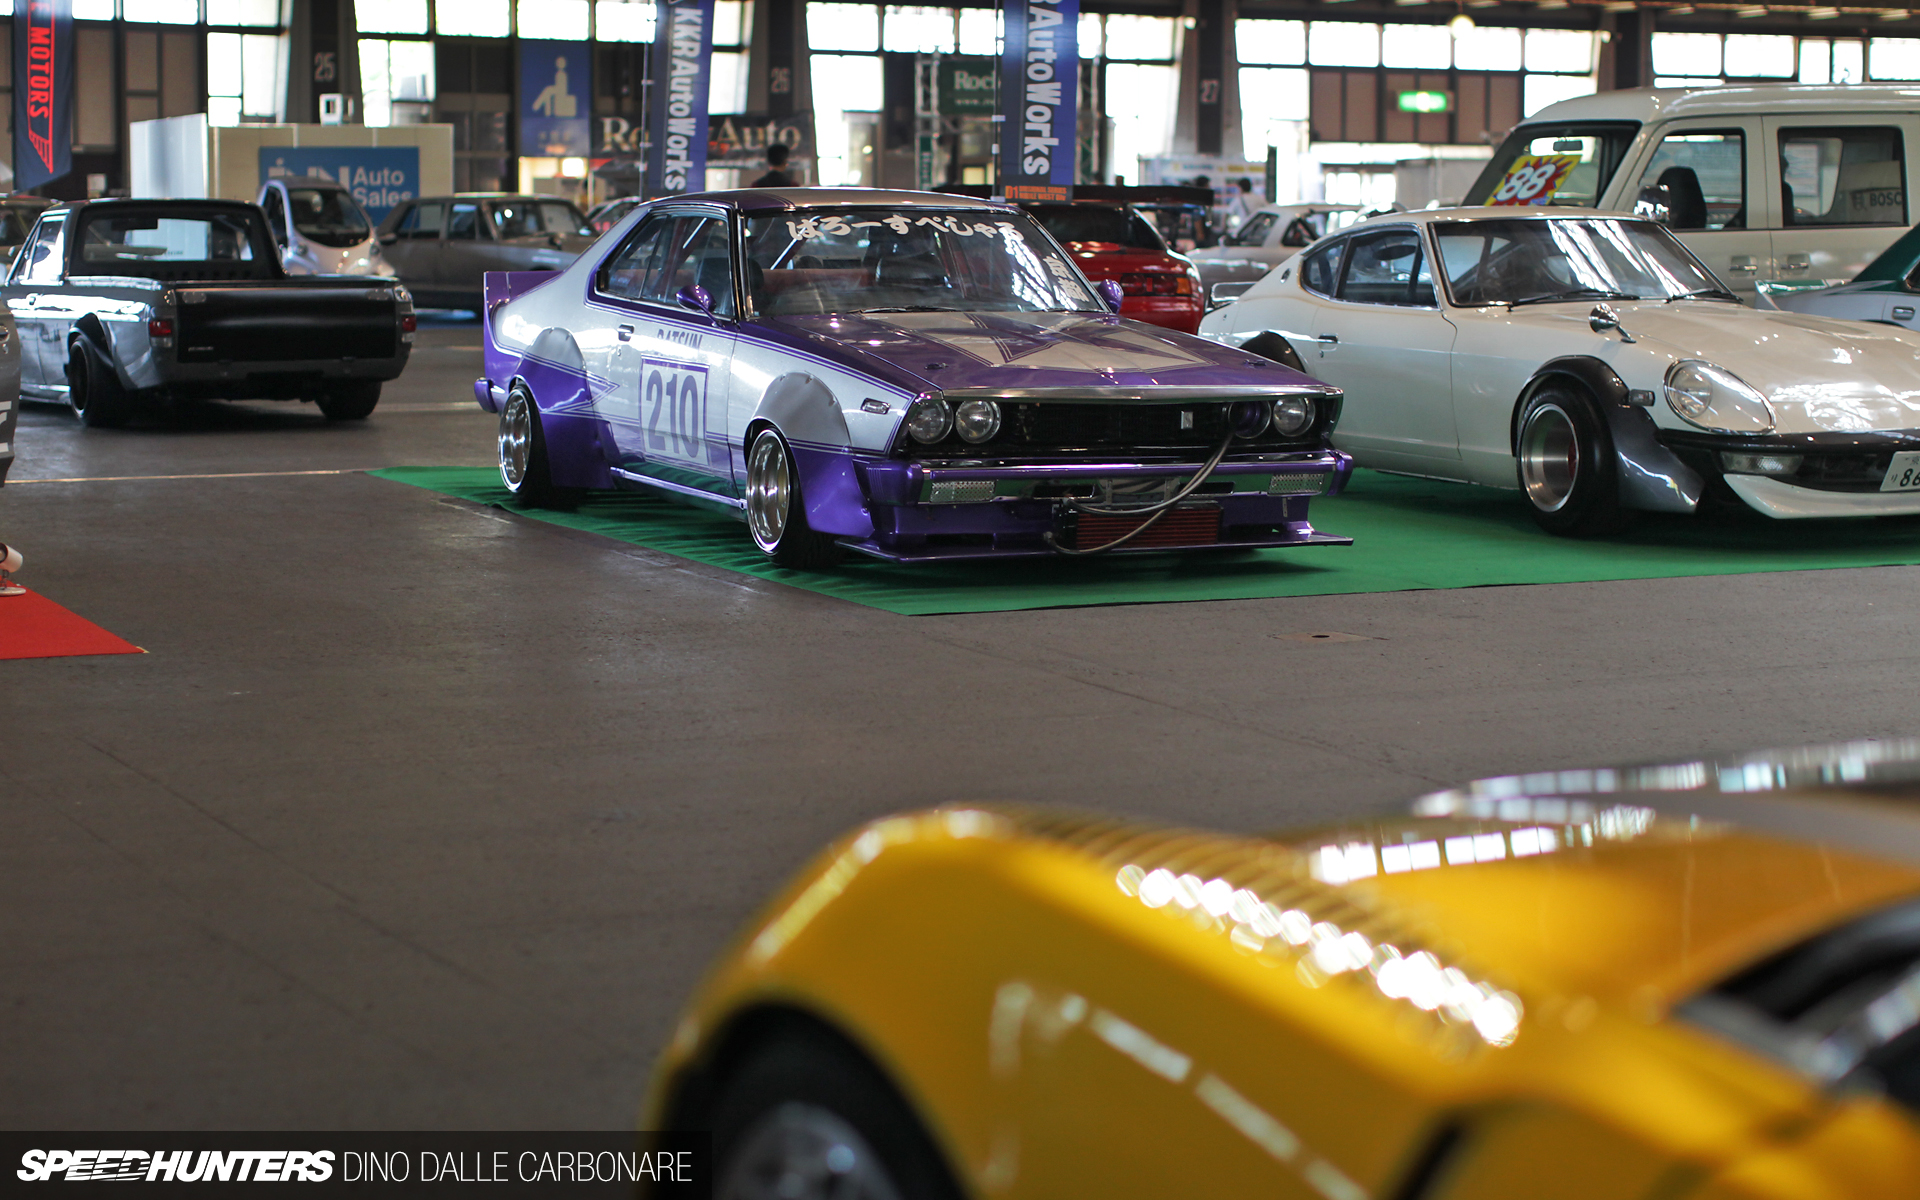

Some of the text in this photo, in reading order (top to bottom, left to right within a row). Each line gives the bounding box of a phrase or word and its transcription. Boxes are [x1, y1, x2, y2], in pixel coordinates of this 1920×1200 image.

[30, 26, 51, 119] MOTORS
[314, 52, 335, 81] 25
[1023, 0, 1063, 175] AutoWorks
[1201, 79, 1219, 103] 27
[353, 167, 405, 187] Auto
[1496, 163, 1557, 202] 88
[646, 369, 700, 458] 210
